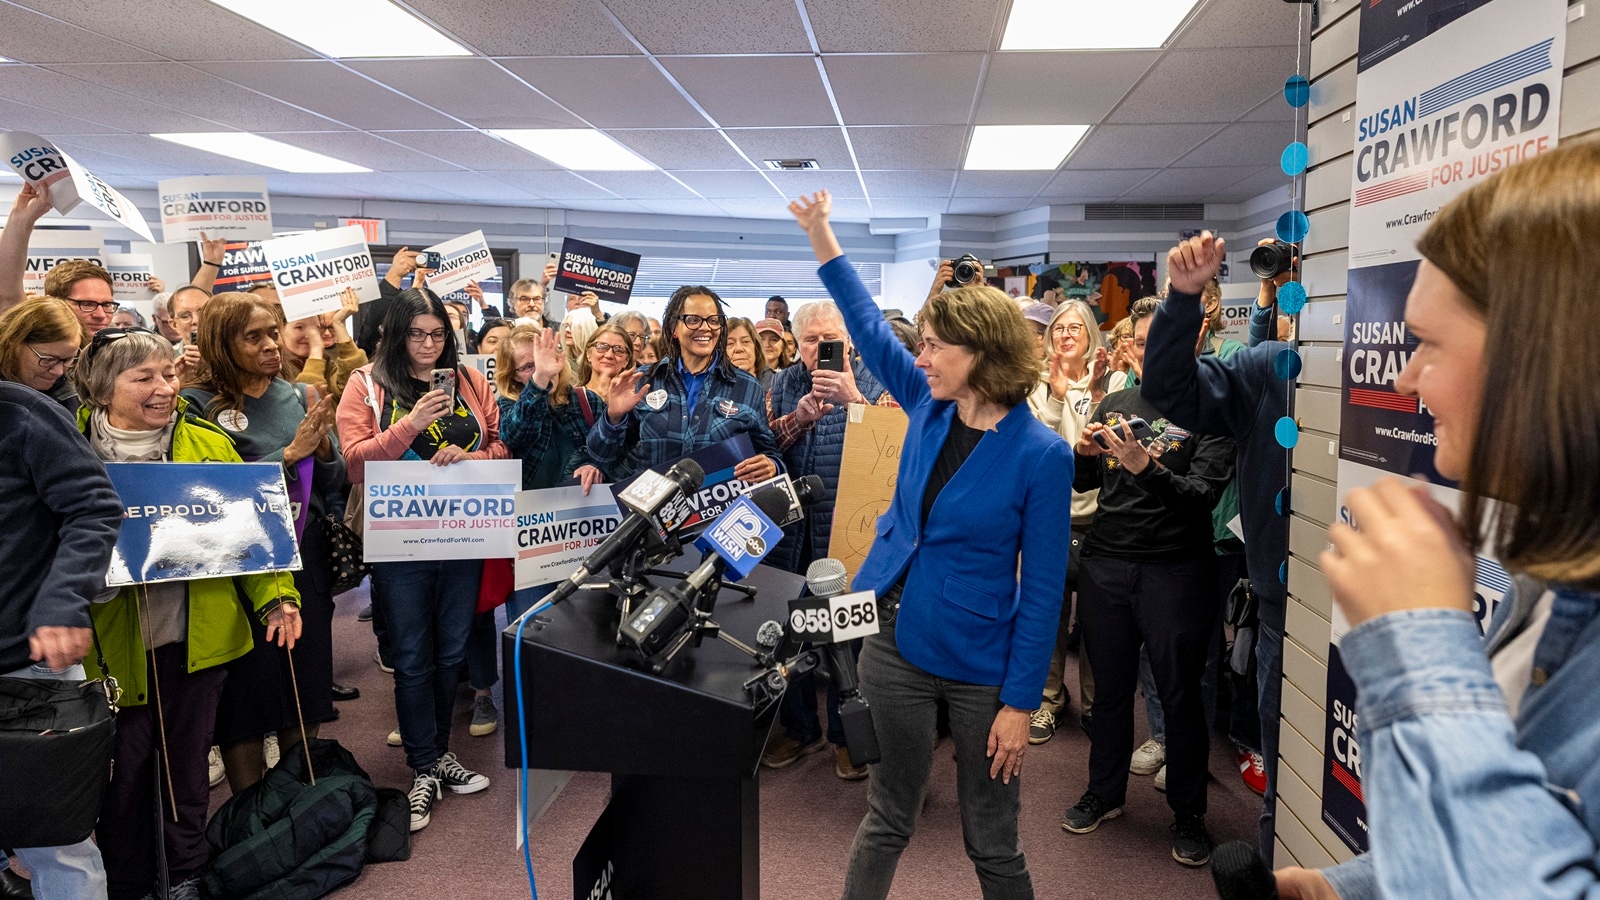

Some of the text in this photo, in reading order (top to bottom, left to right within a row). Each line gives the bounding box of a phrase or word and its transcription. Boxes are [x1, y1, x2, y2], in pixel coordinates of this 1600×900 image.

[1358, 96, 1417, 143] SUSAN
[1356, 82, 1550, 183] CRAWFORD
[1431, 160, 1463, 188] FOR
[162, 192, 199, 203] SUSAN
[163, 201, 267, 216] CRAWFORD
[272, 253, 316, 271] SUSAN
[471, 257, 491, 269] JUSTICE
[565, 252, 594, 265] SUSAN
[223, 265, 269, 276] FOR SUPREM
[277, 254, 370, 287] CRAWFORD
[334, 269, 374, 285] FOR JUSTICE
[563, 261, 632, 284] CRAWFORD
[596, 278, 631, 290] FOR JUSTICE
[1352, 321, 1406, 345] SUSAN
[1375, 426, 1439, 446] www.CrawfordFo
[369, 484, 425, 497] SUSAN
[369, 498, 515, 519] CRAWFORD
[700, 505, 723, 519] FOR
[441, 519, 515, 529] FOR JUSTICE
[517, 511, 554, 527] SUSAN
[517, 517, 619, 548] CRAWFORD
[564, 540, 581, 551] FOR
[713, 527, 743, 559] WISN
[747, 537, 764, 555] abc
